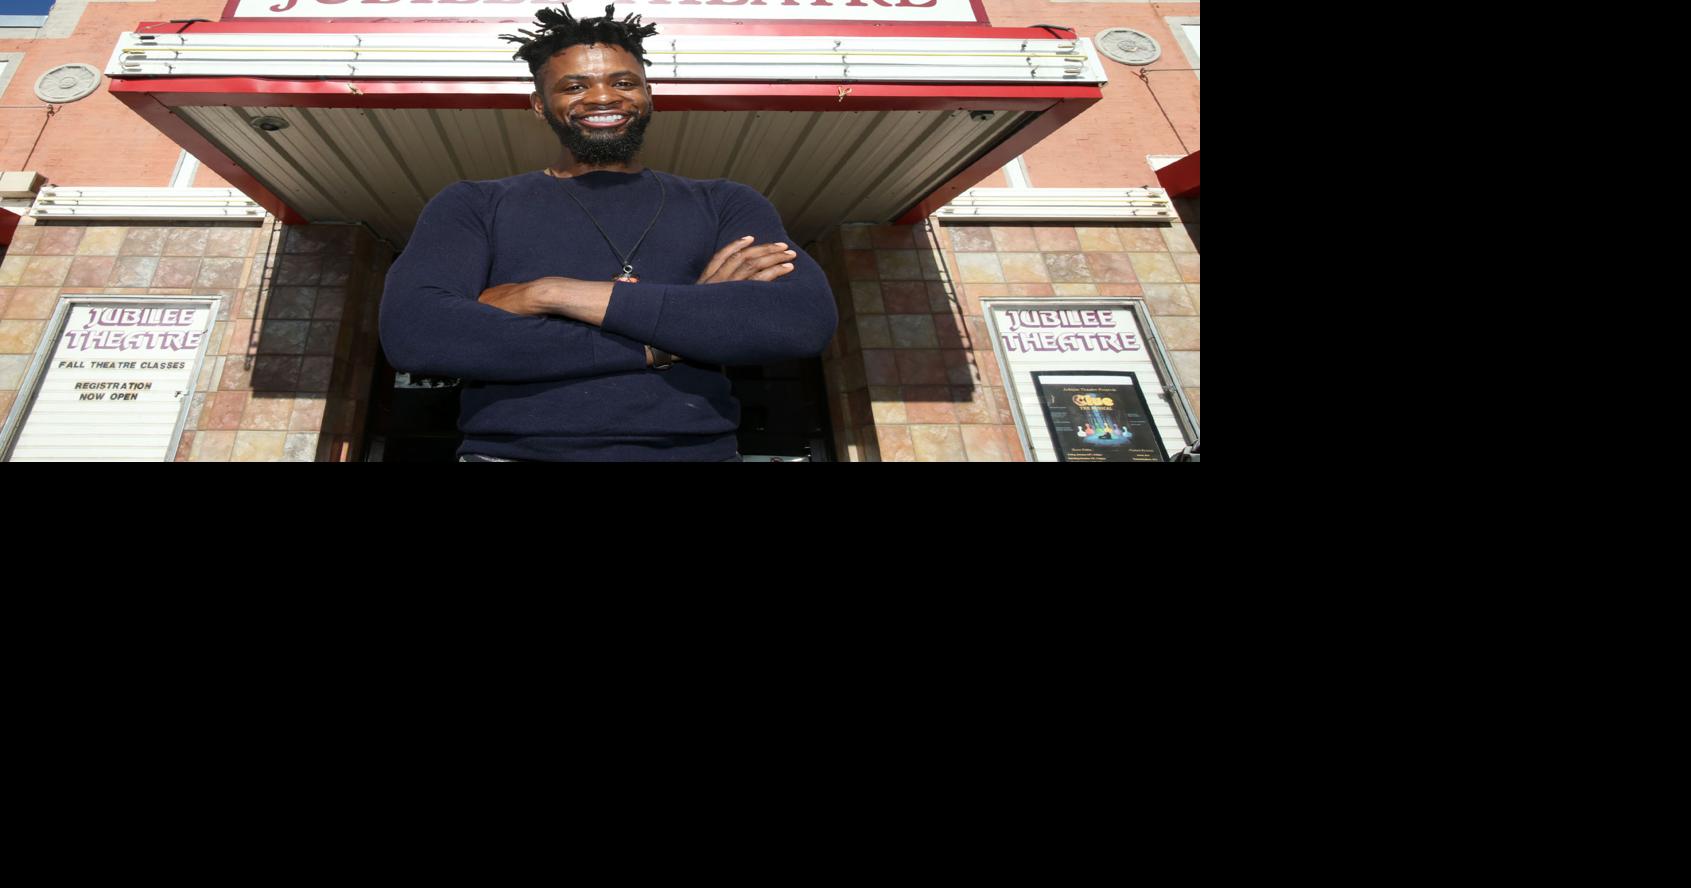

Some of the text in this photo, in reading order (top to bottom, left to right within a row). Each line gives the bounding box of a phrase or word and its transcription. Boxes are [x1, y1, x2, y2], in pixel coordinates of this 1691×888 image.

[83, 308, 196, 329] JUBILEE
[1006, 310, 1116, 331] JUBILEE
[65, 330, 202, 351] THEATRE
[1001, 332, 1141, 353] THEATRE
[58, 361, 186, 369] FALL THEATRE CLASSES
[75, 382, 152, 390] REGISTRATION
[79, 393, 138, 401] NOW OPEN
